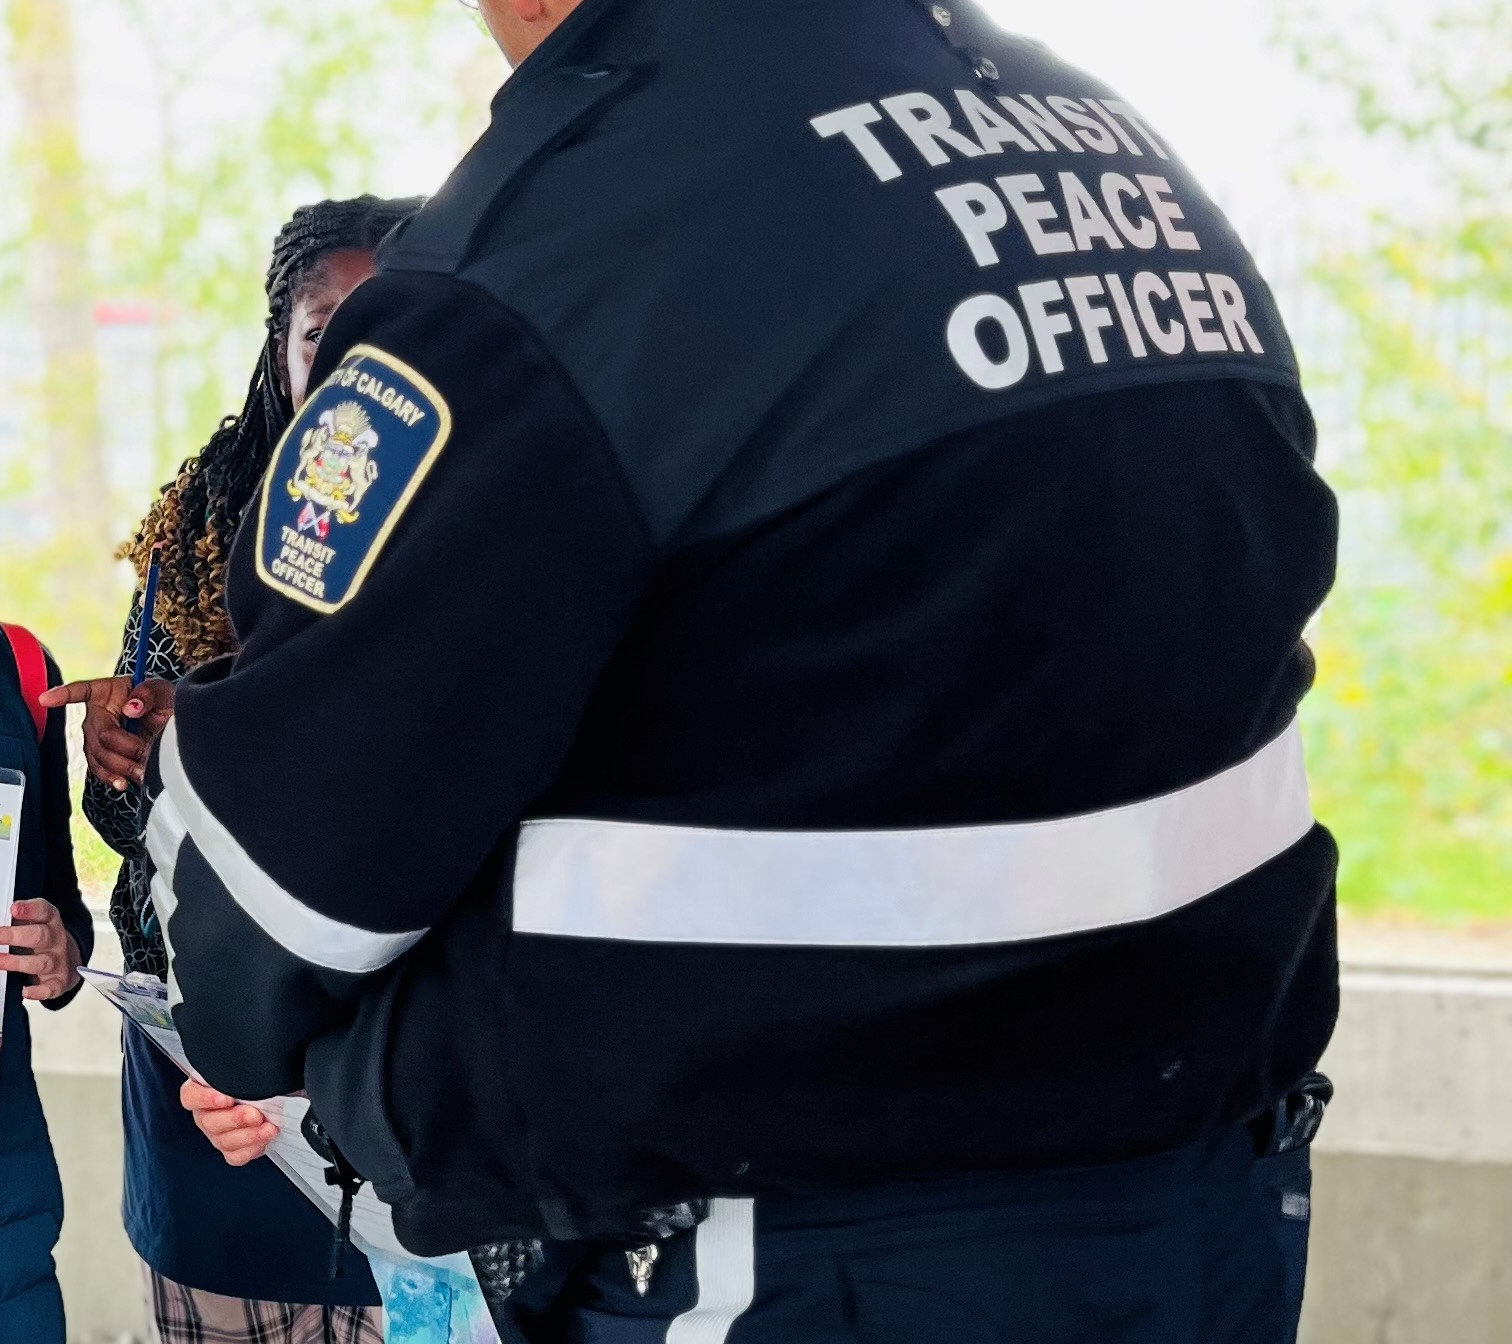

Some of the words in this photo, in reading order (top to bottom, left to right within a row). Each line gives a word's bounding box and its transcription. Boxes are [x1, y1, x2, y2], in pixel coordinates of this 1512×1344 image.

[810, 89, 1171, 183] TRANSIT
[934, 171, 1202, 268] PEACE
[946, 270, 1265, 390] OFFICER
[356, 372, 426, 428] CALGARY
[279, 544, 325, 578] PEACE
[281, 525, 337, 565] TRANSIT
[271, 558, 326, 599] OFFICER
